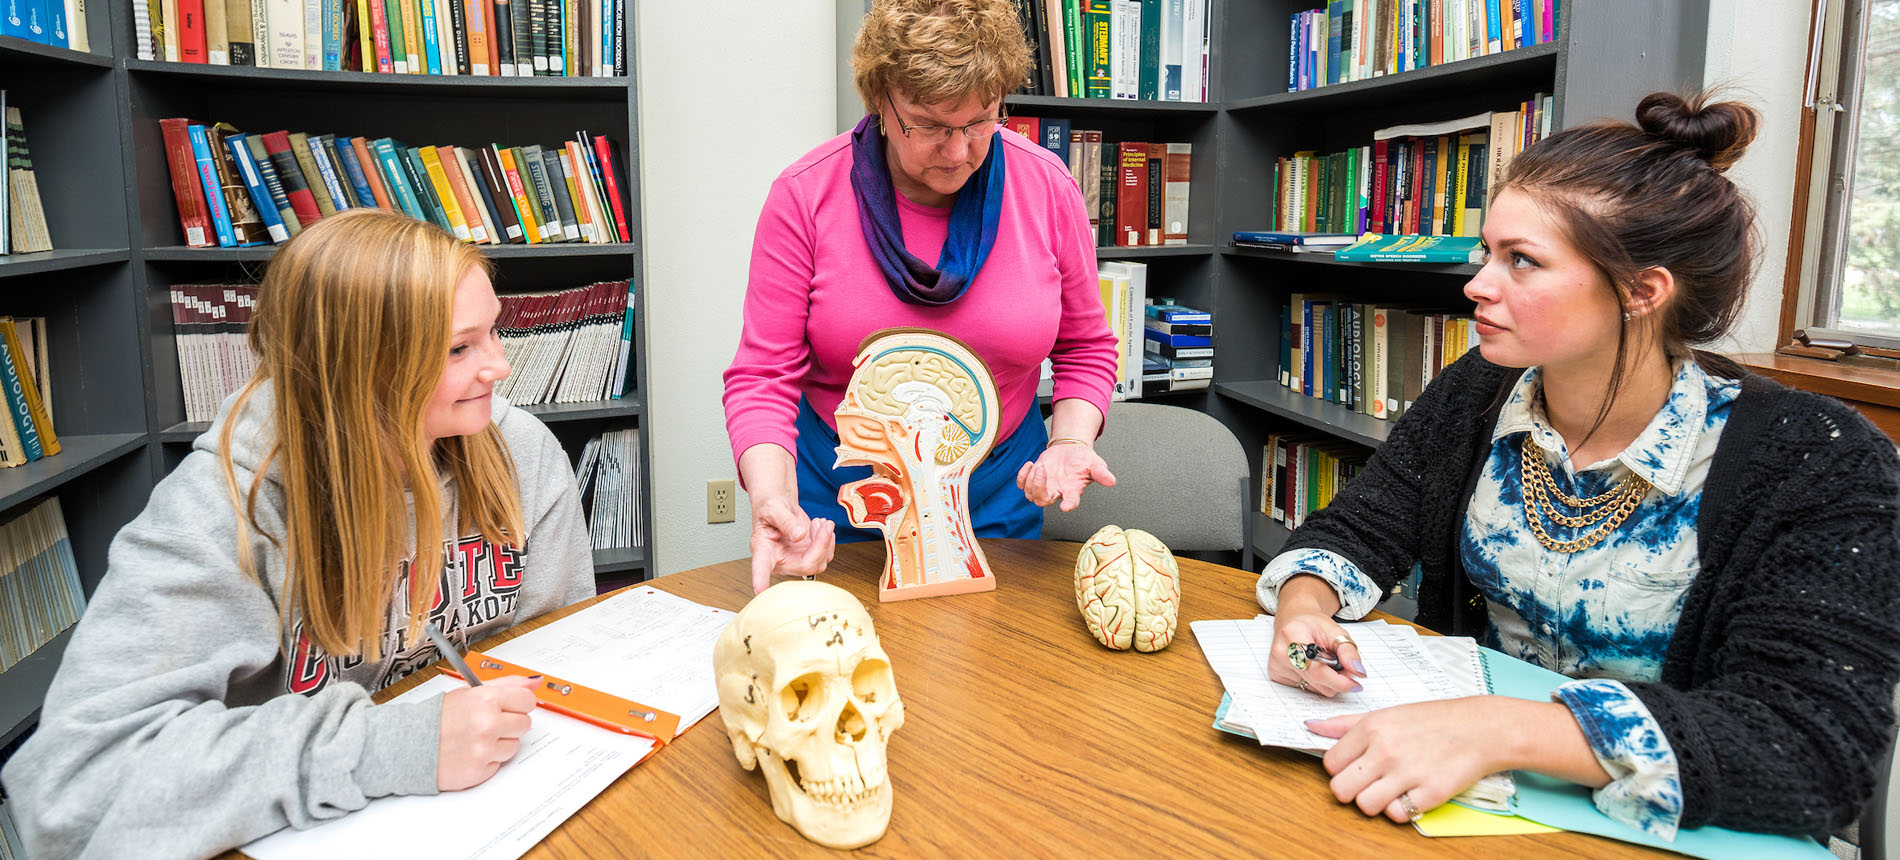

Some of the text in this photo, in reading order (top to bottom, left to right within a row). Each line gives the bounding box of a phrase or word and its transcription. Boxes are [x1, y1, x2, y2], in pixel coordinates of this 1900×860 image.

[259, 30, 267, 65] Intervention
[456, 30, 464, 63] DISORDERS
[1098, 21, 1109, 65] STEDMAN'S
[201, 164, 214, 186] Speech
[208, 187, 221, 219] Correction
[508, 170, 522, 195] Parent
[518, 198, 531, 217] Child
[531, 164, 550, 207] STUTTERING
[1, 344, 36, 435] AUDIOLOGY
